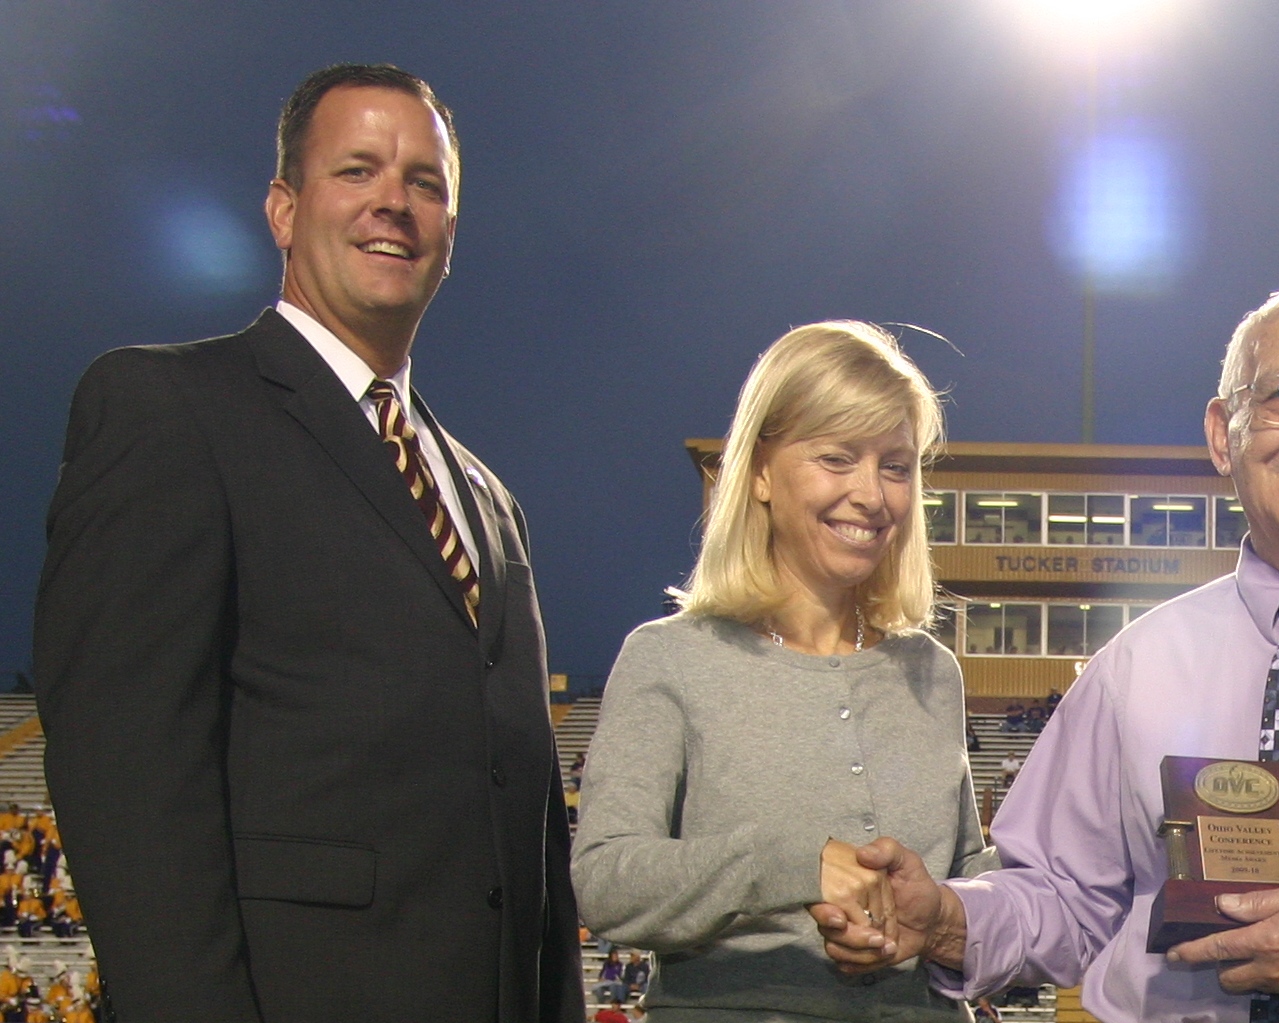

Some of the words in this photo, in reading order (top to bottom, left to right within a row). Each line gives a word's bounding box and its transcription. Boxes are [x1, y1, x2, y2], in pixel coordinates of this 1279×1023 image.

[996, 556, 1078, 572] TUCKER
[1092, 557, 1180, 574] STADIUM
[1212, 775, 1260, 797] OVC
